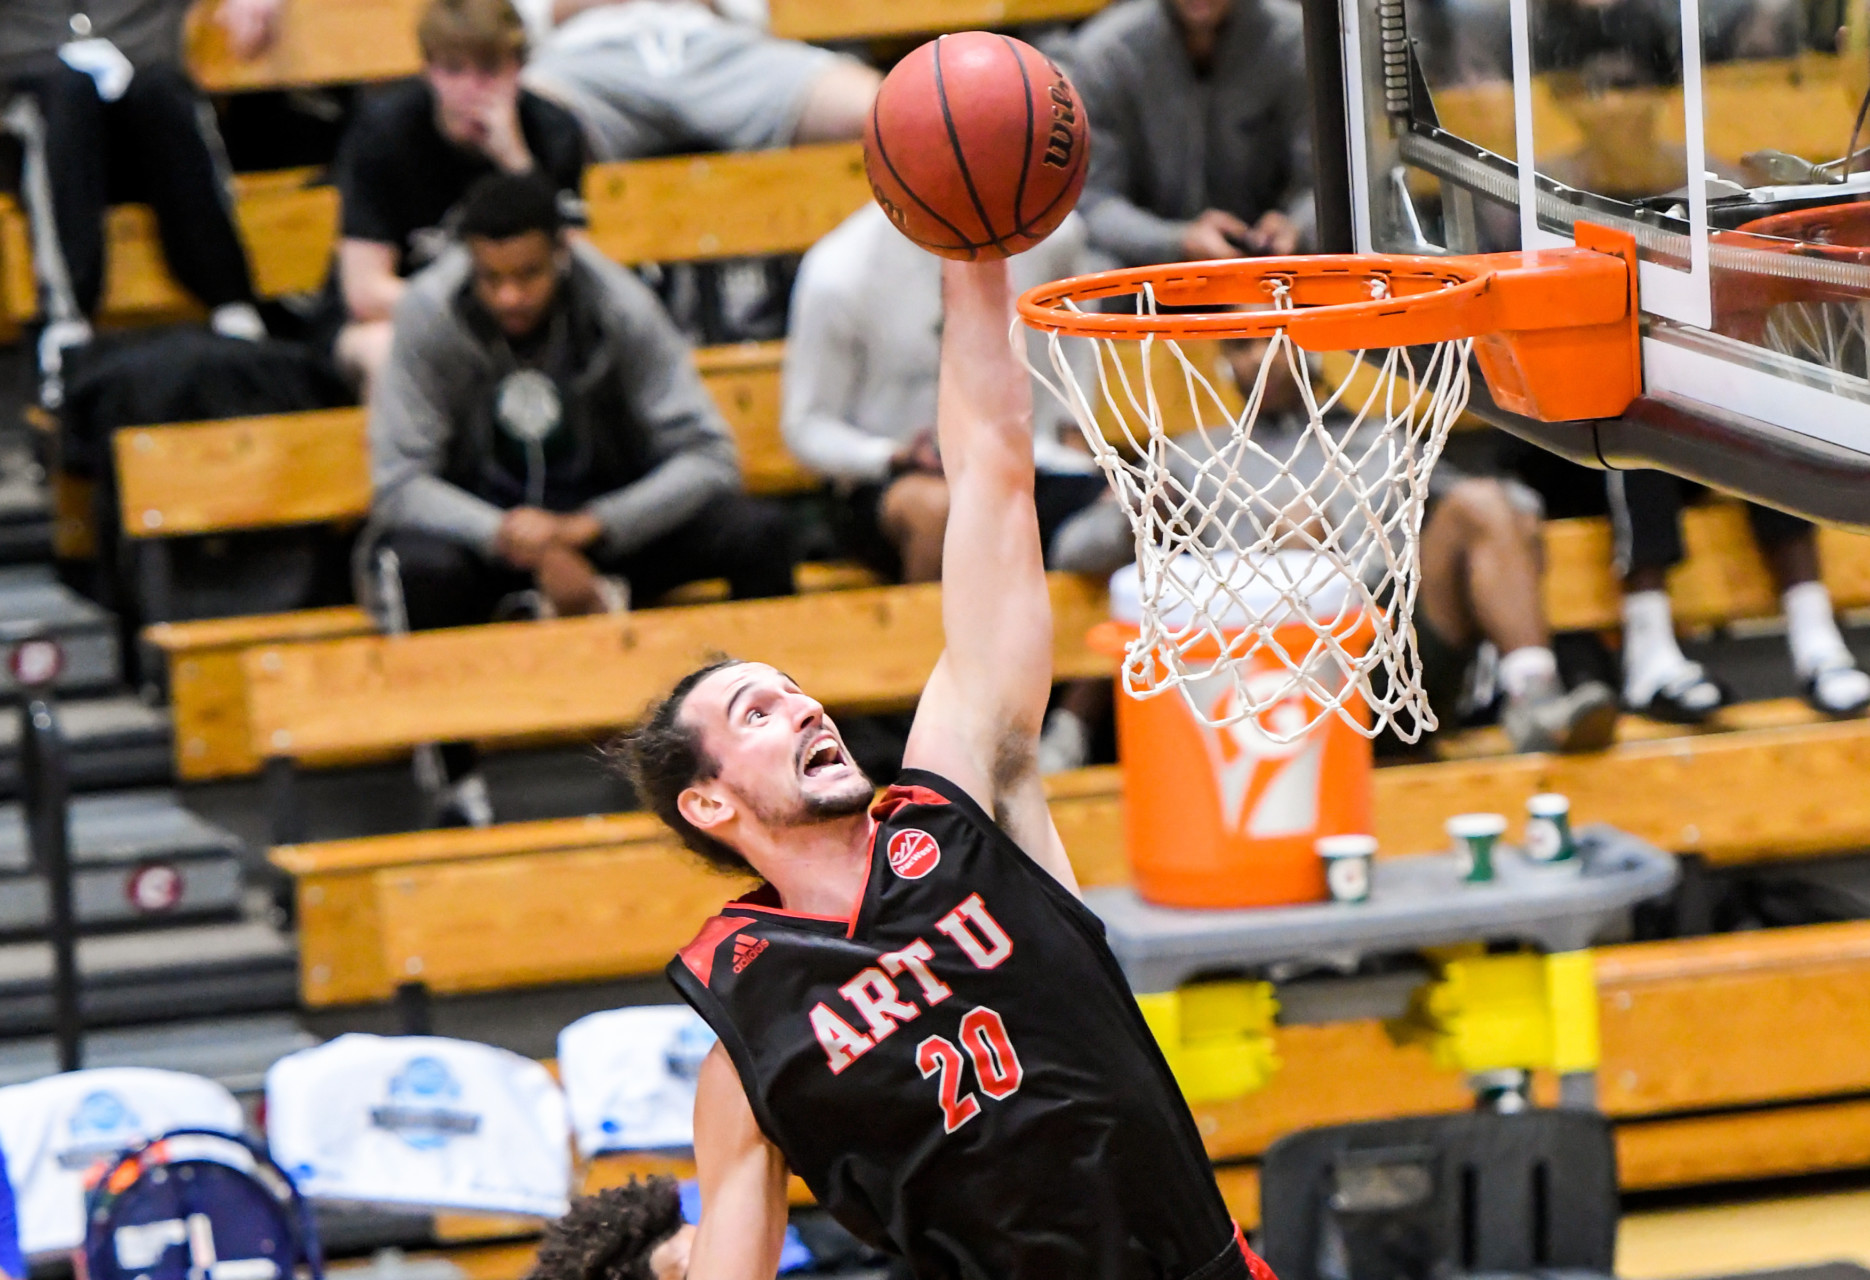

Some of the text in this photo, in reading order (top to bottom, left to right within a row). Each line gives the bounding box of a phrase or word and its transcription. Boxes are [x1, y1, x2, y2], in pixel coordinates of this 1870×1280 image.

[897, 843, 935, 875] PacWest
[733, 938, 770, 974] adidas
[808, 891, 1014, 1076] ART U
[915, 1005, 1024, 1135] 20
